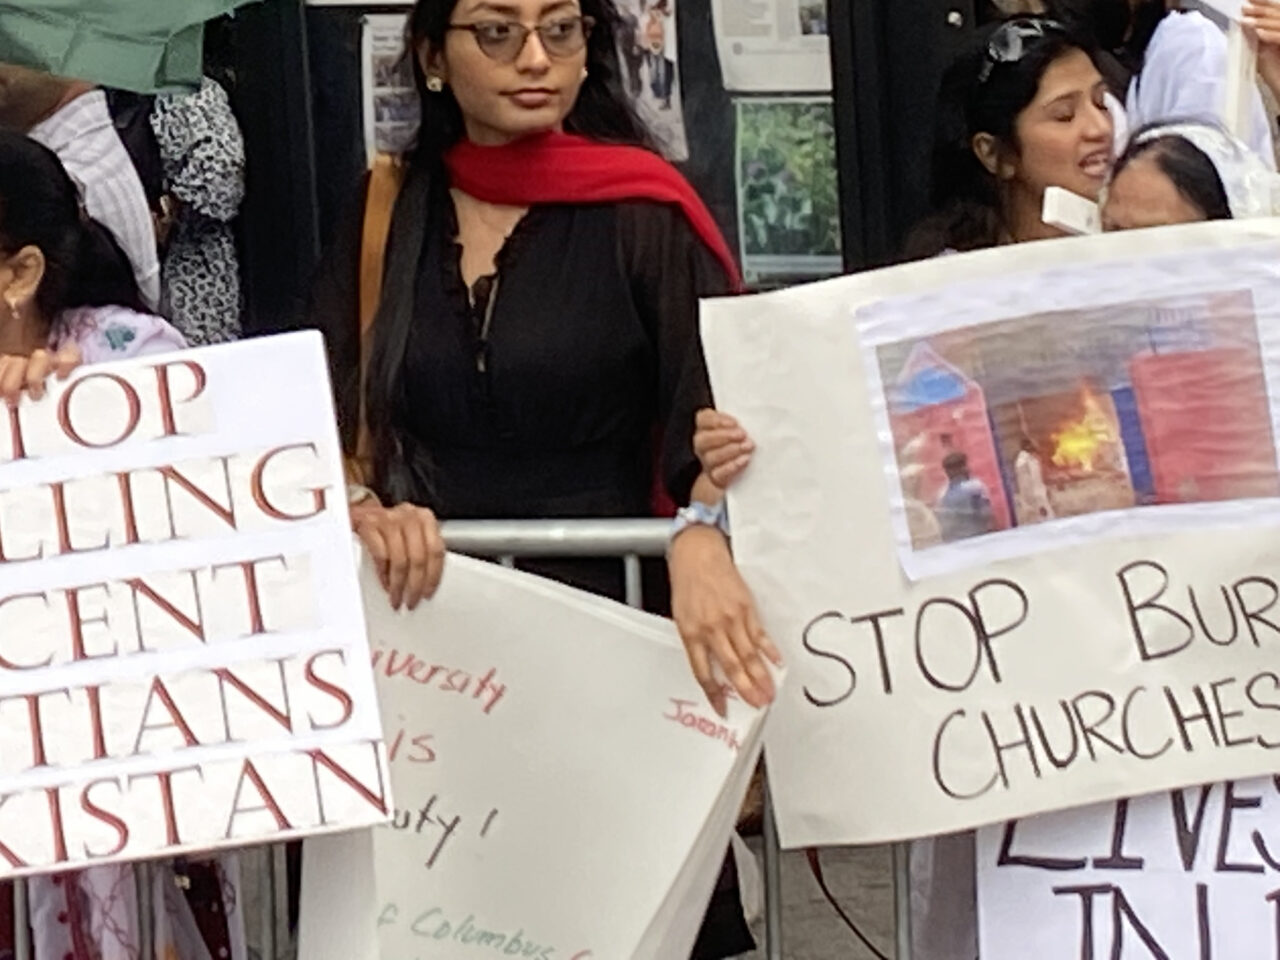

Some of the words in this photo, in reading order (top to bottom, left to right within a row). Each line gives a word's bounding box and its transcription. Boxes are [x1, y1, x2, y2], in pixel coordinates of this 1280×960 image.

[802, 578, 1029, 707] STOP
[1116, 560, 1280, 662] BUR
[387, 714, 436, 763] is
[933, 672, 1280, 800] CHURCHES
[1052, 883, 1212, 960] IN
